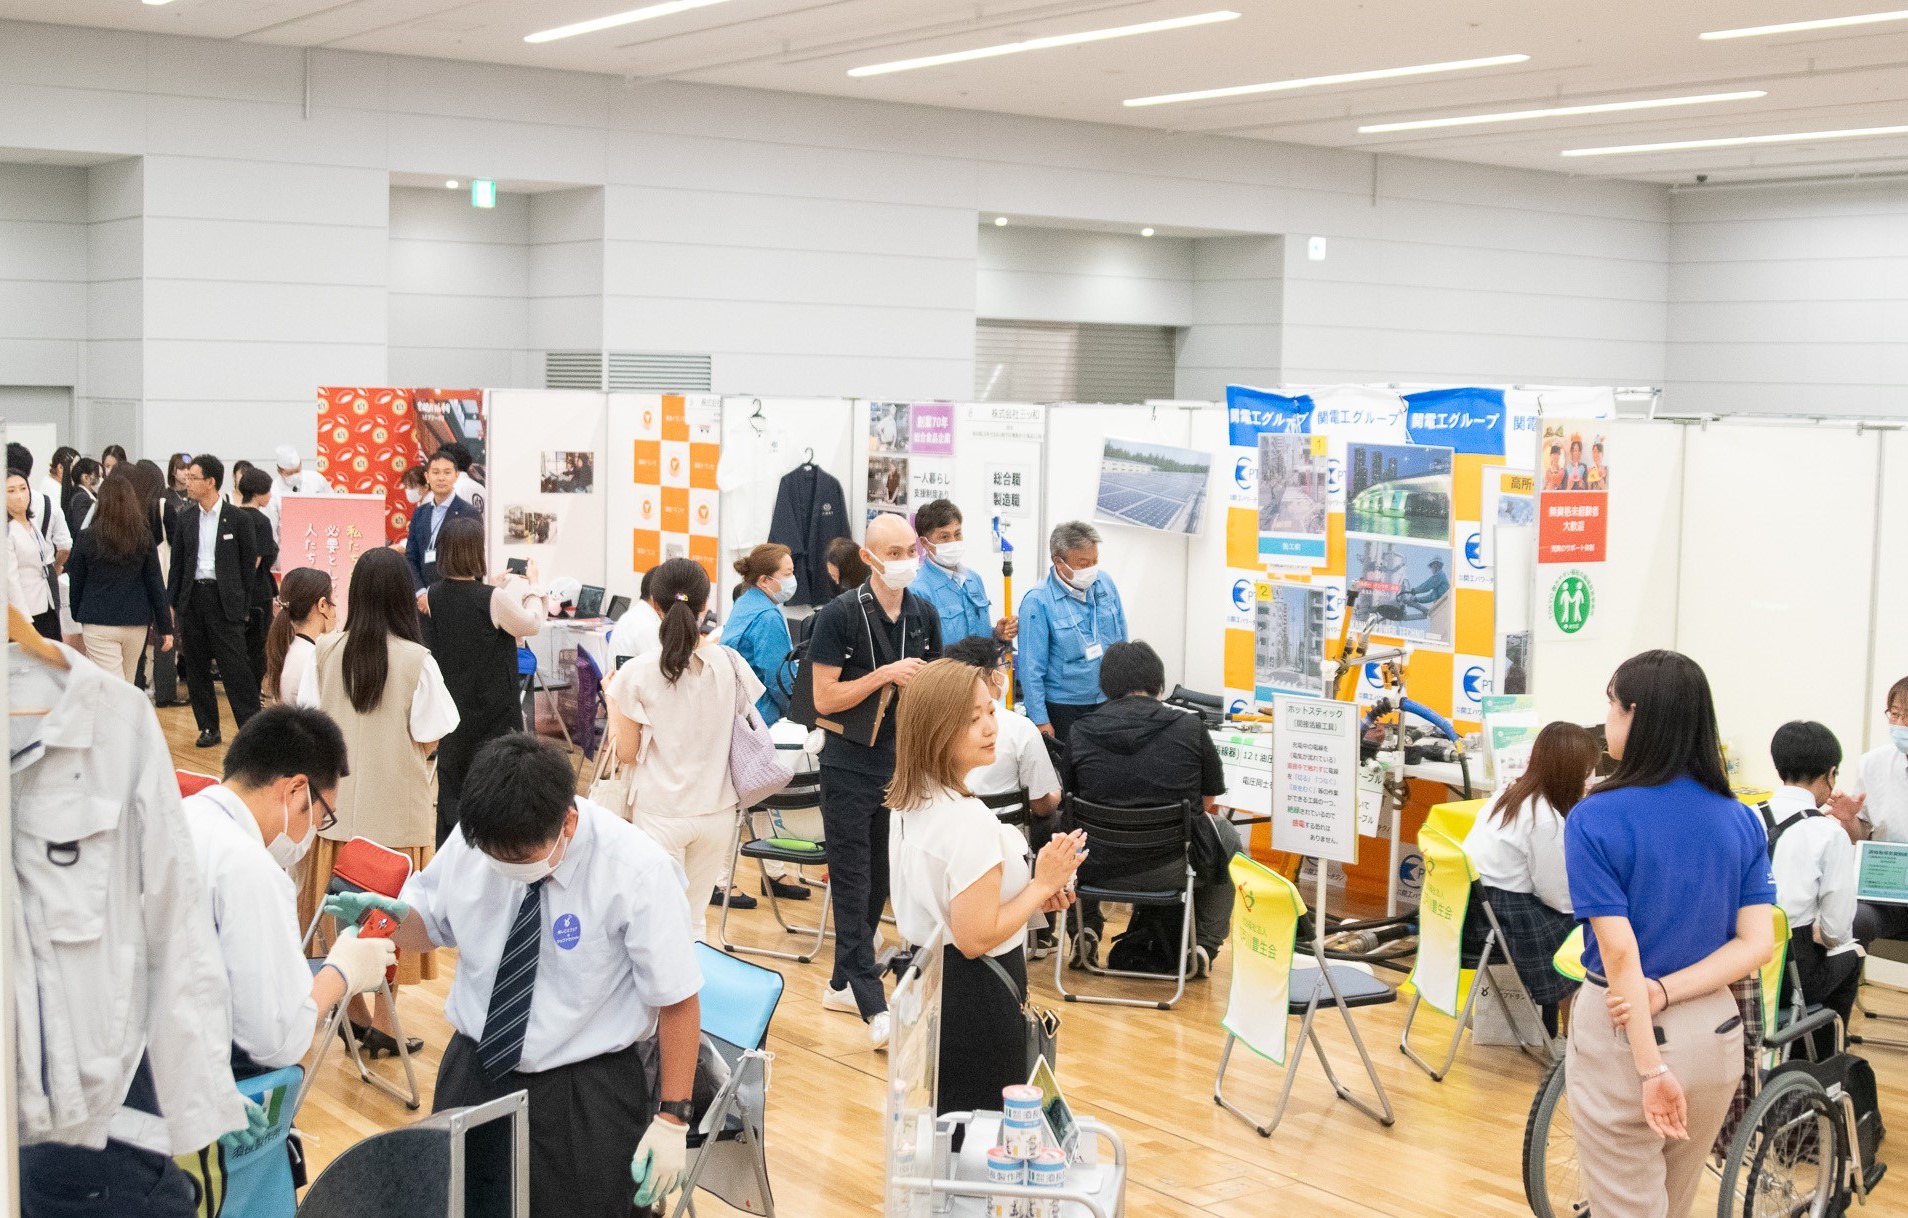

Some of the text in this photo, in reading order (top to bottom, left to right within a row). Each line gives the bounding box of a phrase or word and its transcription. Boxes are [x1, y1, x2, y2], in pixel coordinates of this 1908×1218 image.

[1317, 409, 1403, 427] 関電工グループ
[1411, 411, 1501, 430] 関電工グループ
[1316, 439, 1322, 450] 1
[913, 471, 950, 485] 一人暮らし
[993, 471, 1021, 486] 総合職
[993, 492, 1021, 507] 製造職
[1260, 585, 1269, 597] 2
[1287, 704, 1343, 719] ホットスティック
